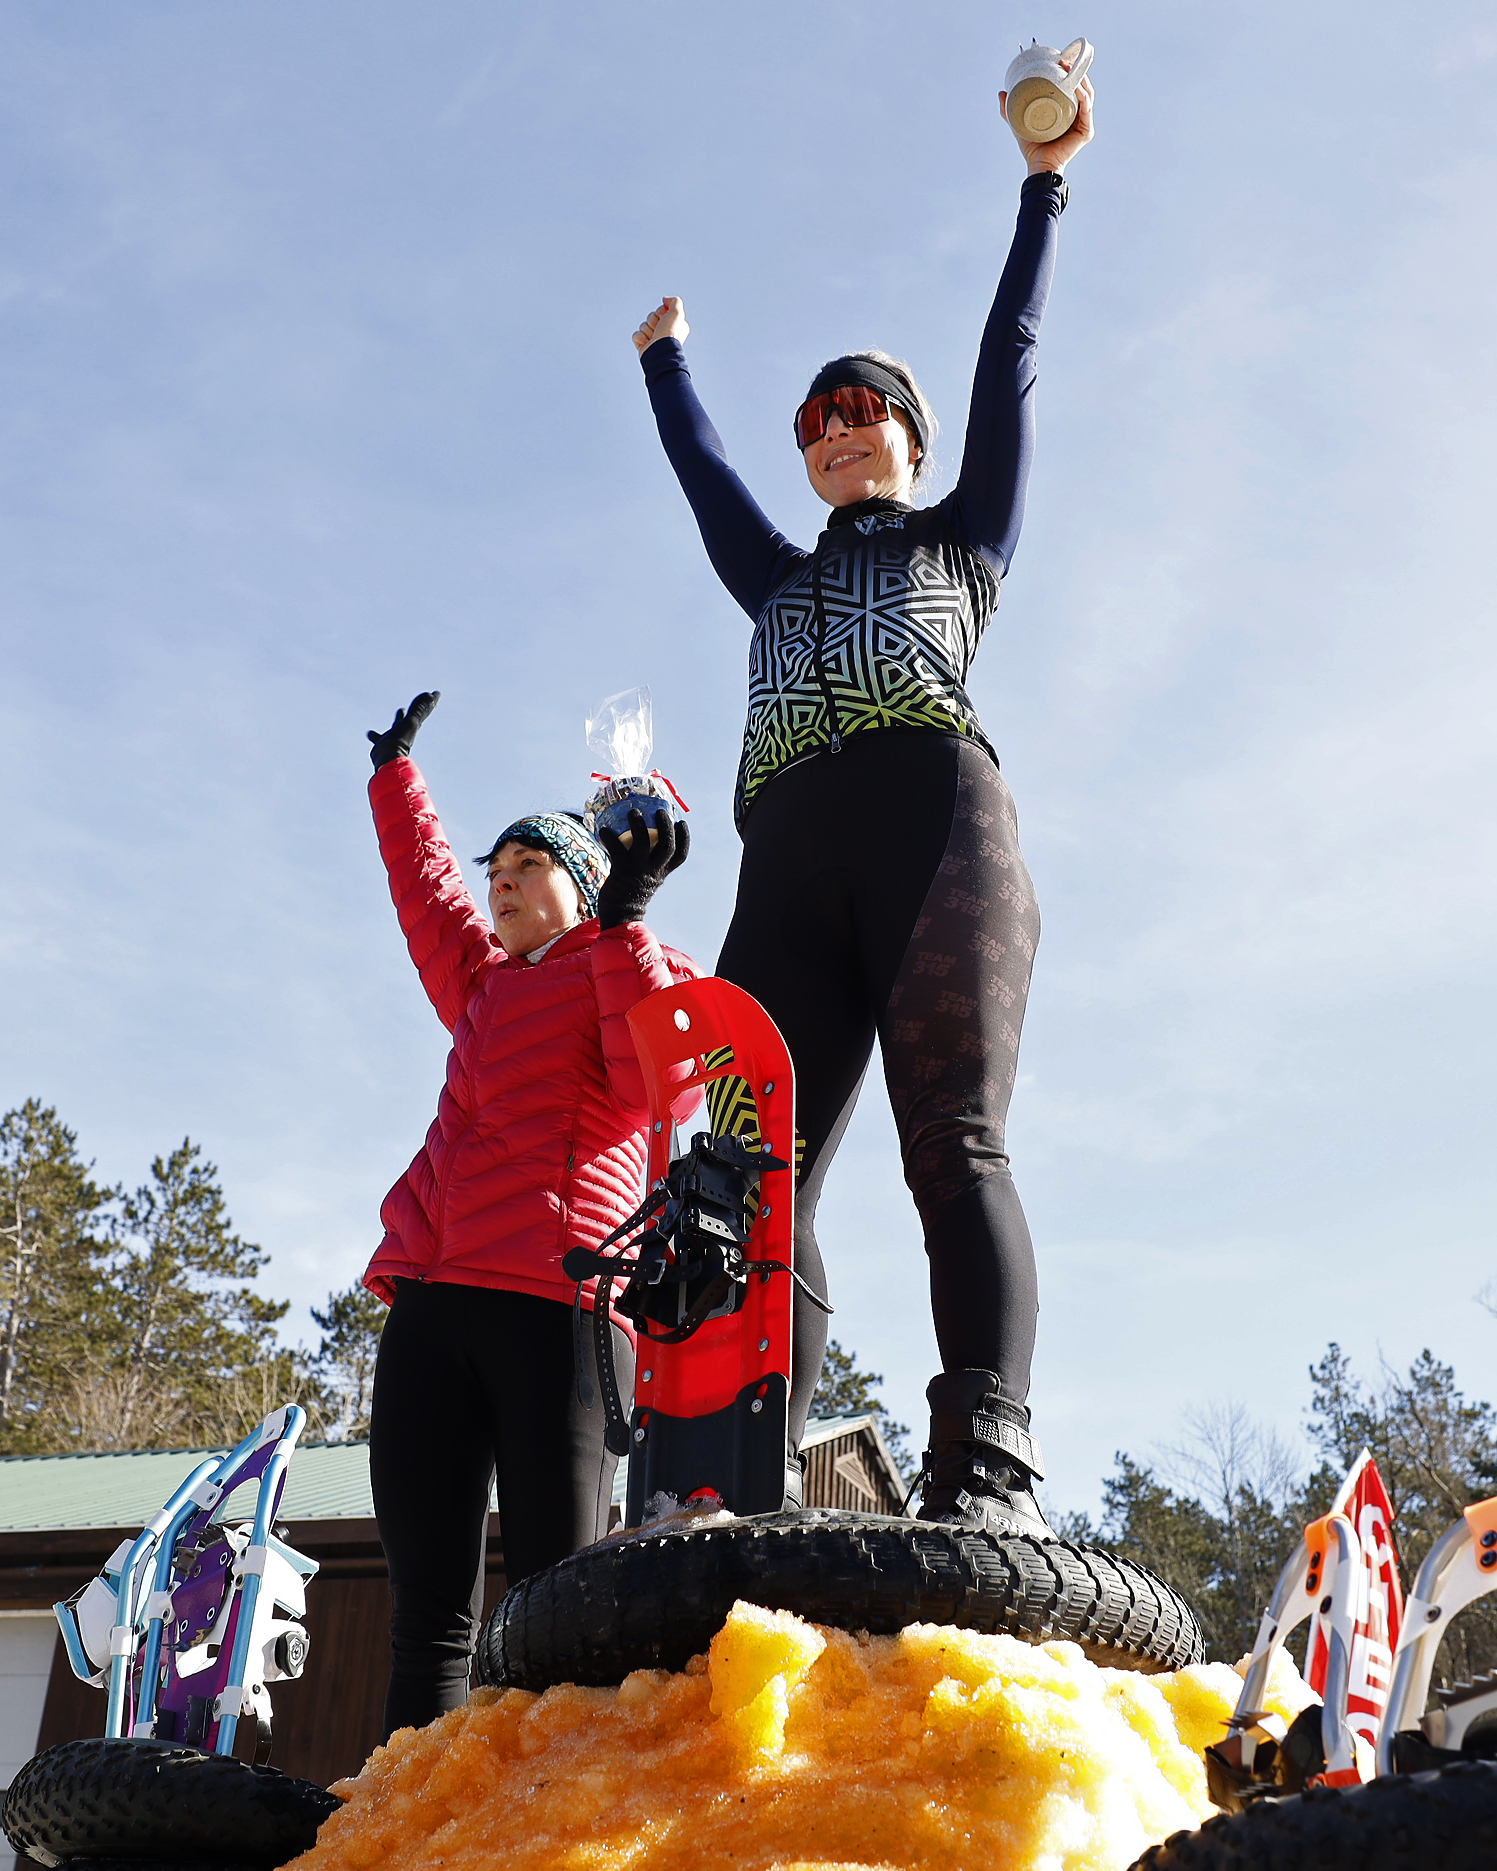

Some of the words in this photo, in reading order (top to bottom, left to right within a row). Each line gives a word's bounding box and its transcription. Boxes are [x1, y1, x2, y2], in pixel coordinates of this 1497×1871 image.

[977, 845, 1010, 869] 315
[981, 837, 1015, 863] TEAM
[942, 896, 984, 918] 315
[949, 887, 989, 908] TEAM
[967, 938, 1002, 963] 315
[973, 929, 1006, 955] TEAM
[912, 960, 951, 977] 315
[917, 951, 957, 966] TEAM
[940, 989, 978, 1008] TEAM
[986, 983, 1013, 1009] 315
[934, 998, 973, 1019] 315
[893, 1019, 926, 1030] TEAM
[892, 1028, 921, 1043] 315
[912, 1063, 943, 1080] 315
[914, 1055, 948, 1068] TEAM
